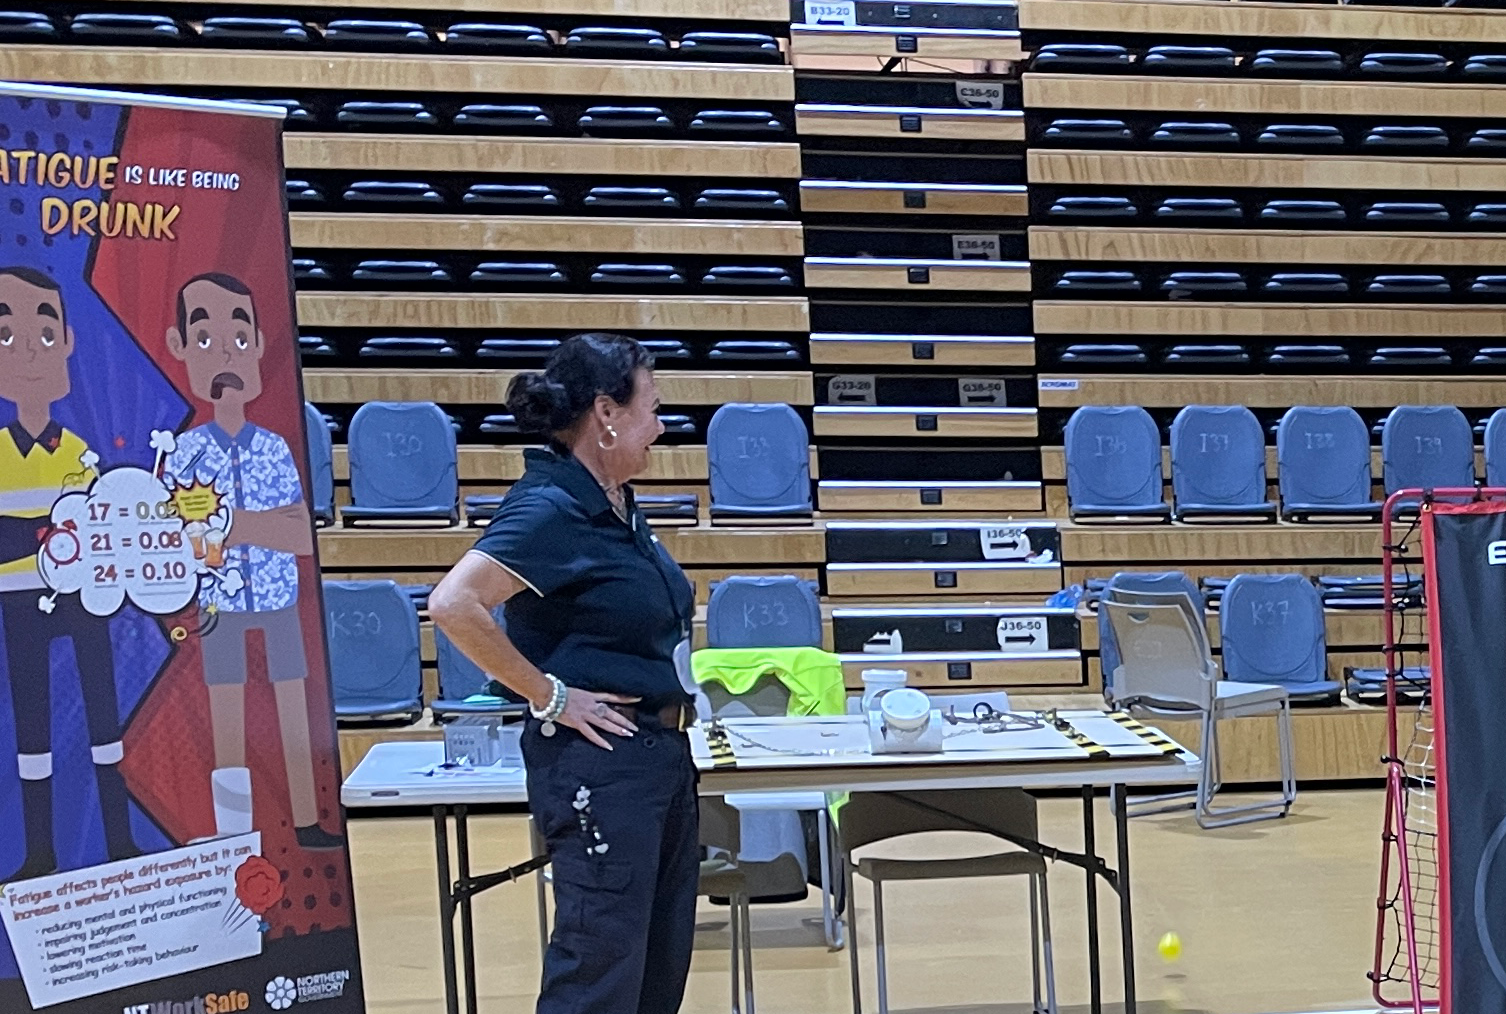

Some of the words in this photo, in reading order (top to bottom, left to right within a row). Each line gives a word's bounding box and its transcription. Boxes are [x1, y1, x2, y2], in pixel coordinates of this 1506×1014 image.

[124, 165, 143, 184] IS
[149, 168, 187, 187] LIKE
[192, 171, 240, 191] BEING
[41, 197, 181, 240] DRUNK
[88, 503, 111, 521] 17
[136, 500, 179, 520] 0.05
[90, 533, 112, 551] 21
[139, 530, 182, 550] 0.08
[93, 564, 118, 583] 24
[142, 561, 186, 580] 0.10
[330, 610, 381, 639] K30
[743, 601, 790, 629] K33
[1251, 599, 1292, 626] K37
[1000, 621, 1041, 631] J36-50
[9, 889, 52, 908] Fatigue
[56, 878, 98, 897] affects
[101, 869, 134, 890] people
[138, 856, 197, 877] differently
[200, 851, 218, 864] but
[222, 848, 231, 860] it
[234, 845, 252, 857] can
[13, 904, 60, 922] increase
[64, 901, 72, 911] a
[75, 887, 120, 907] worker's
[123, 877, 161, 897] hazard
[165, 869, 212, 888] exposure
[41, 919, 82, 935] reducing
[85, 909, 115, 925] mental
[119, 904, 136, 917] and
[138, 895, 175, 915] physical
[178, 886, 227, 903] functioning
[140, 914, 157, 925] and
[52, 967, 99, 986] increasing
[101, 955, 153, 975] risk-taking
[155, 944, 200, 961] behaviour
[85, 949, 125, 965] reaction
[296, 969, 350, 987] NORTHERN
[297, 980, 346, 997] TERRITORY
